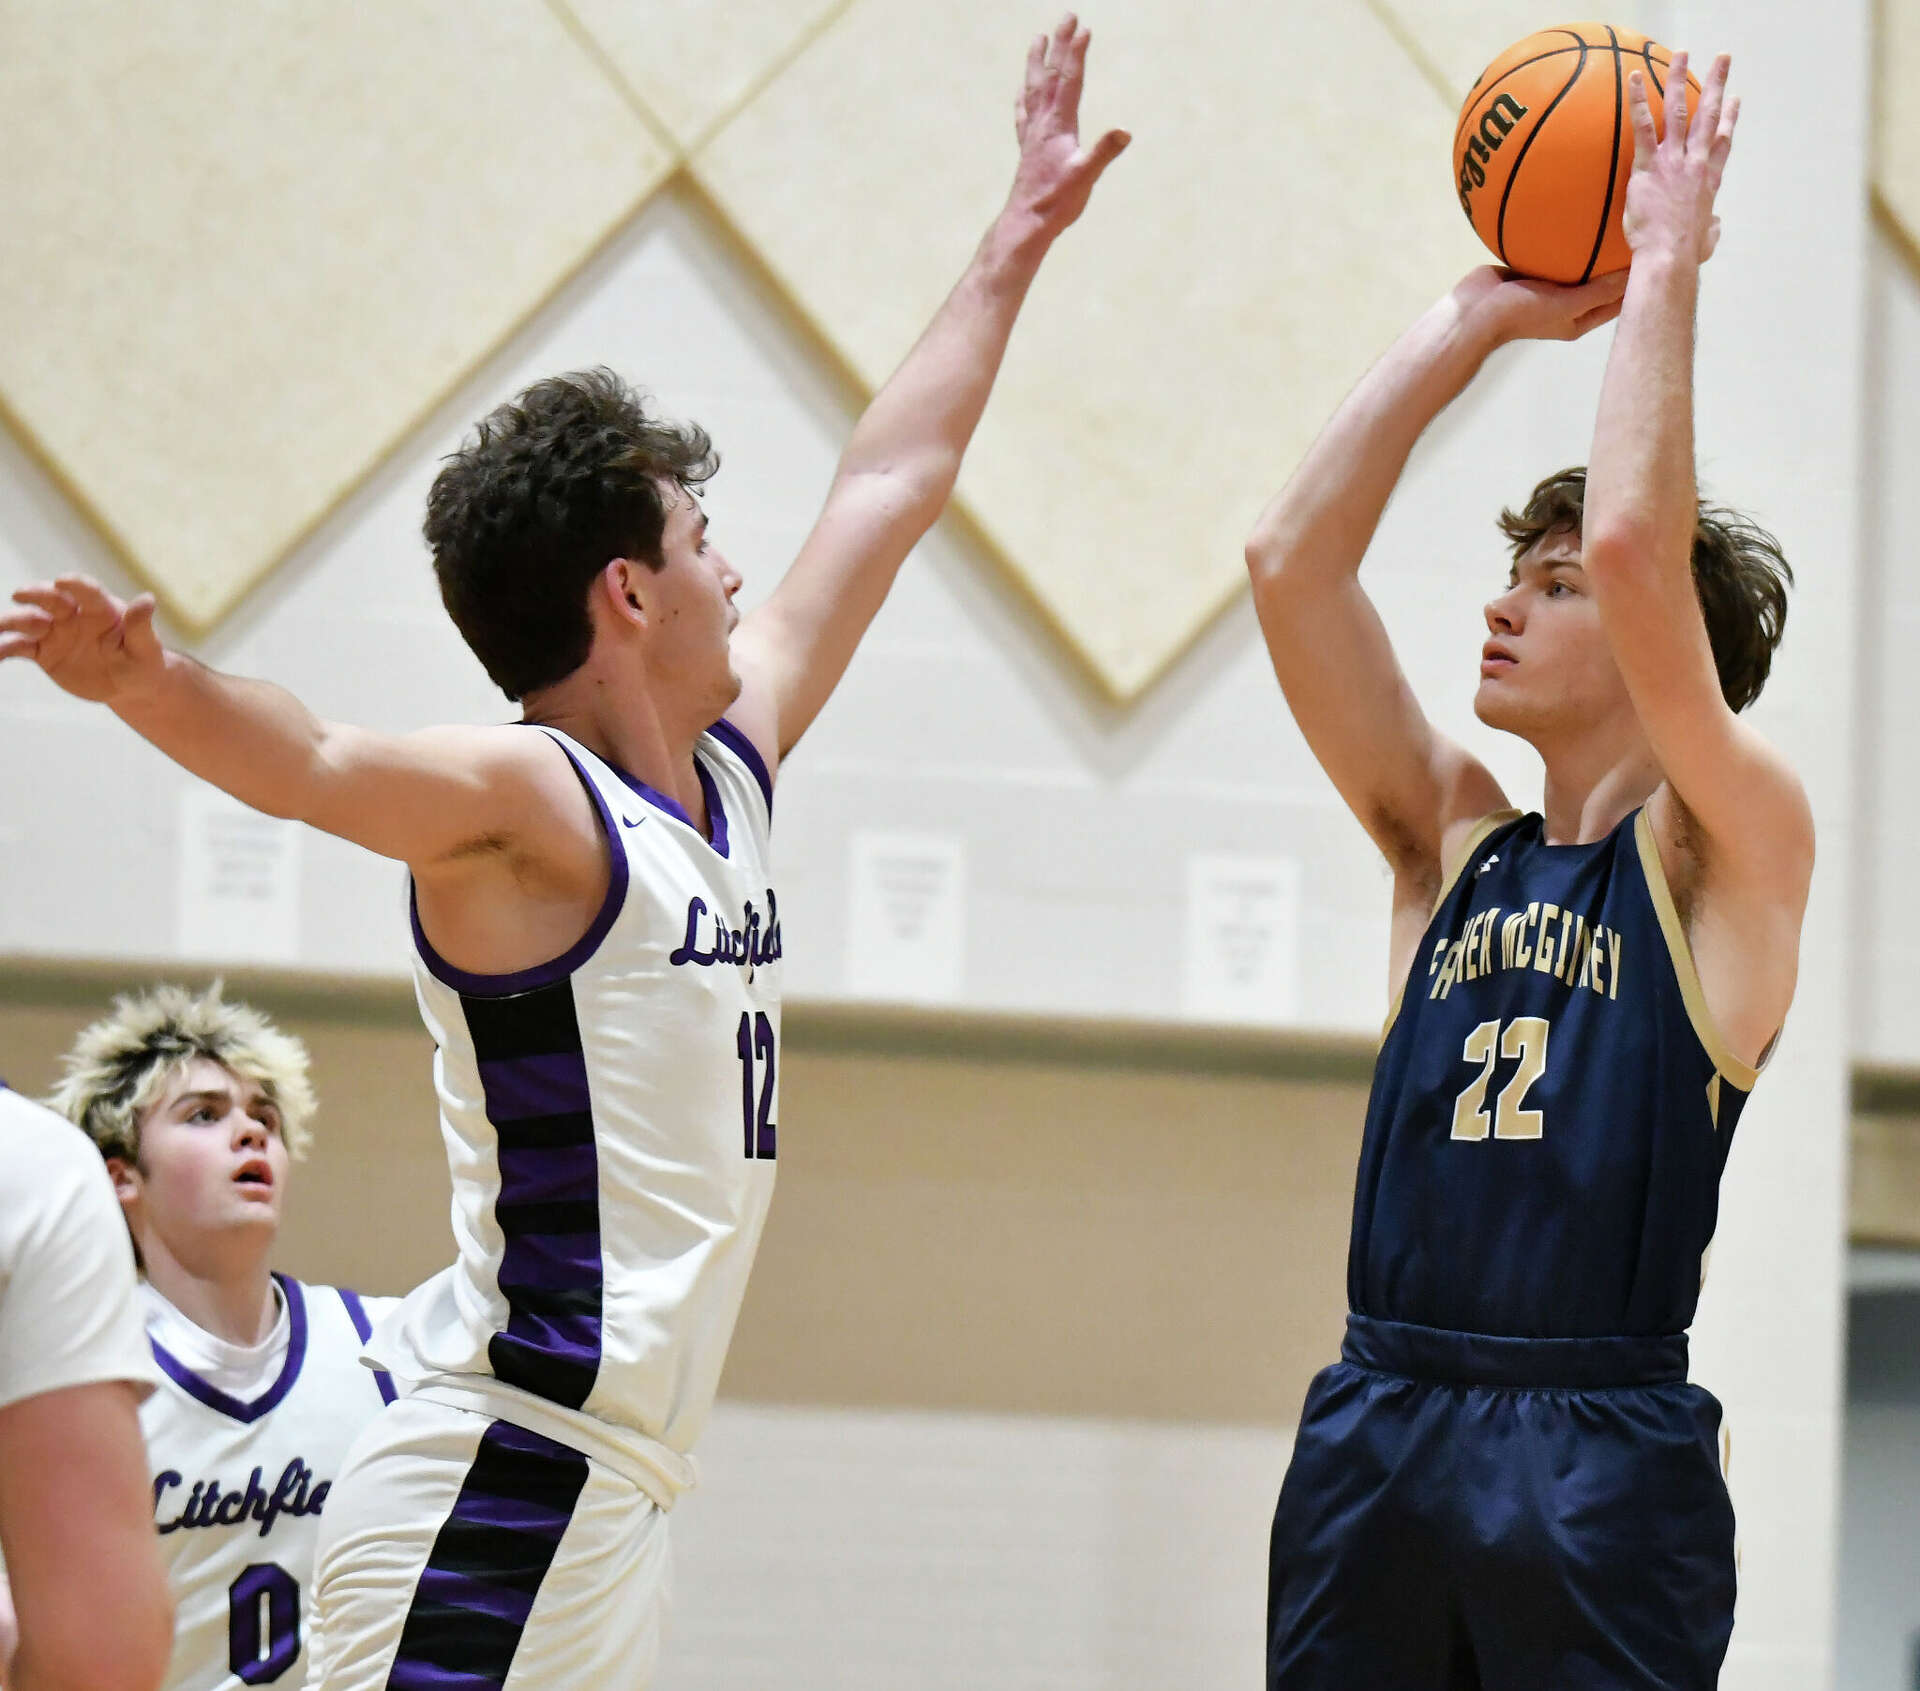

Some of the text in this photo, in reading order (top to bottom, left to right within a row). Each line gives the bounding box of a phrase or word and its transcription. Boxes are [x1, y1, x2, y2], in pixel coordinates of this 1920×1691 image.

[736, 1010, 777, 1160] 12
[1450, 1016, 1550, 1142] 22
[229, 1562, 301, 1686] 0
